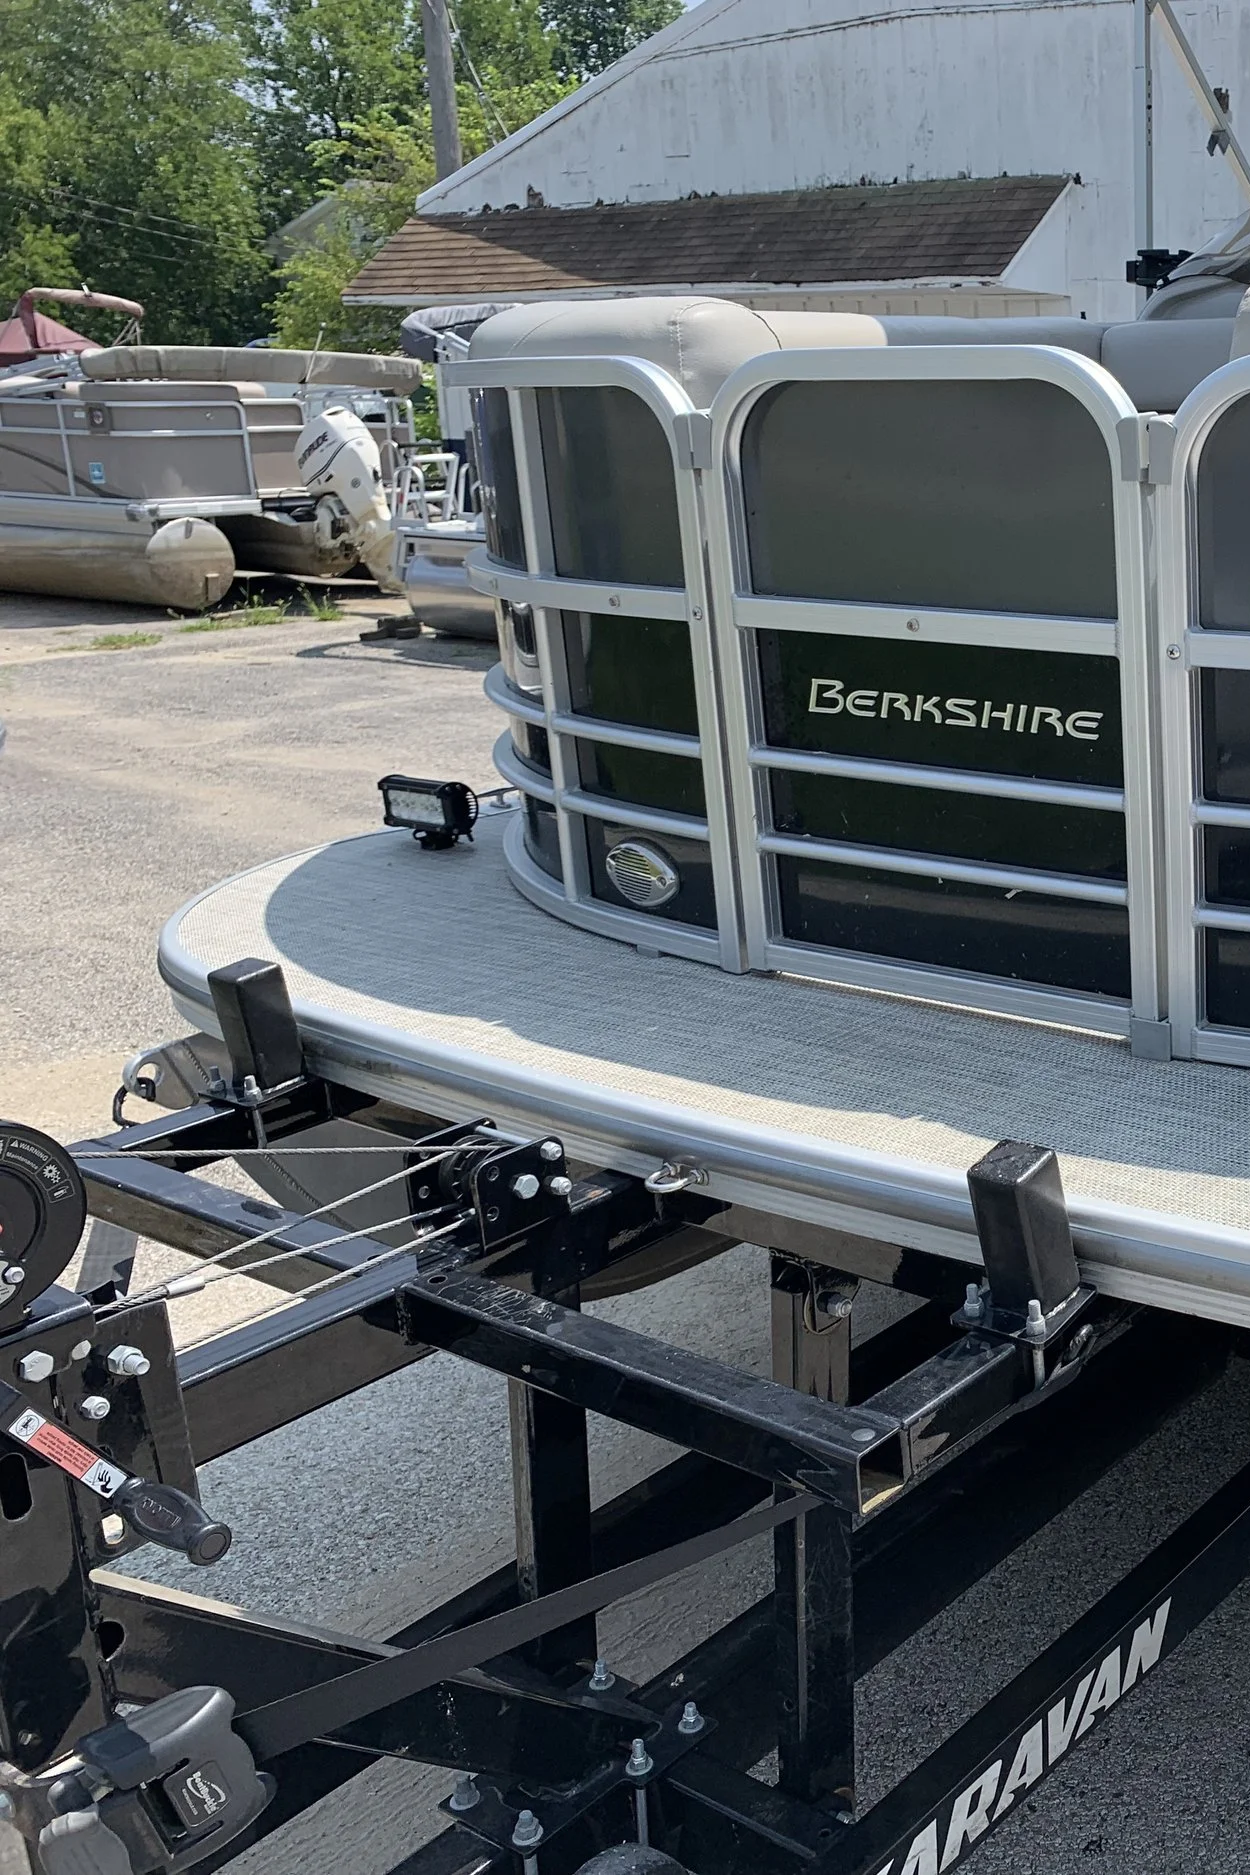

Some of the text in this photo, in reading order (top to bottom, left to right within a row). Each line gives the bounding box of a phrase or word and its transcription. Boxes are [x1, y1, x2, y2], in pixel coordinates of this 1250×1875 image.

[808, 677, 1105, 741] BERKSHIRE
[6, 1151, 39, 1170] Maintenance
[19, 1142, 49, 1162] WARNING
[876, 1596, 1172, 1875] ARAVAN
